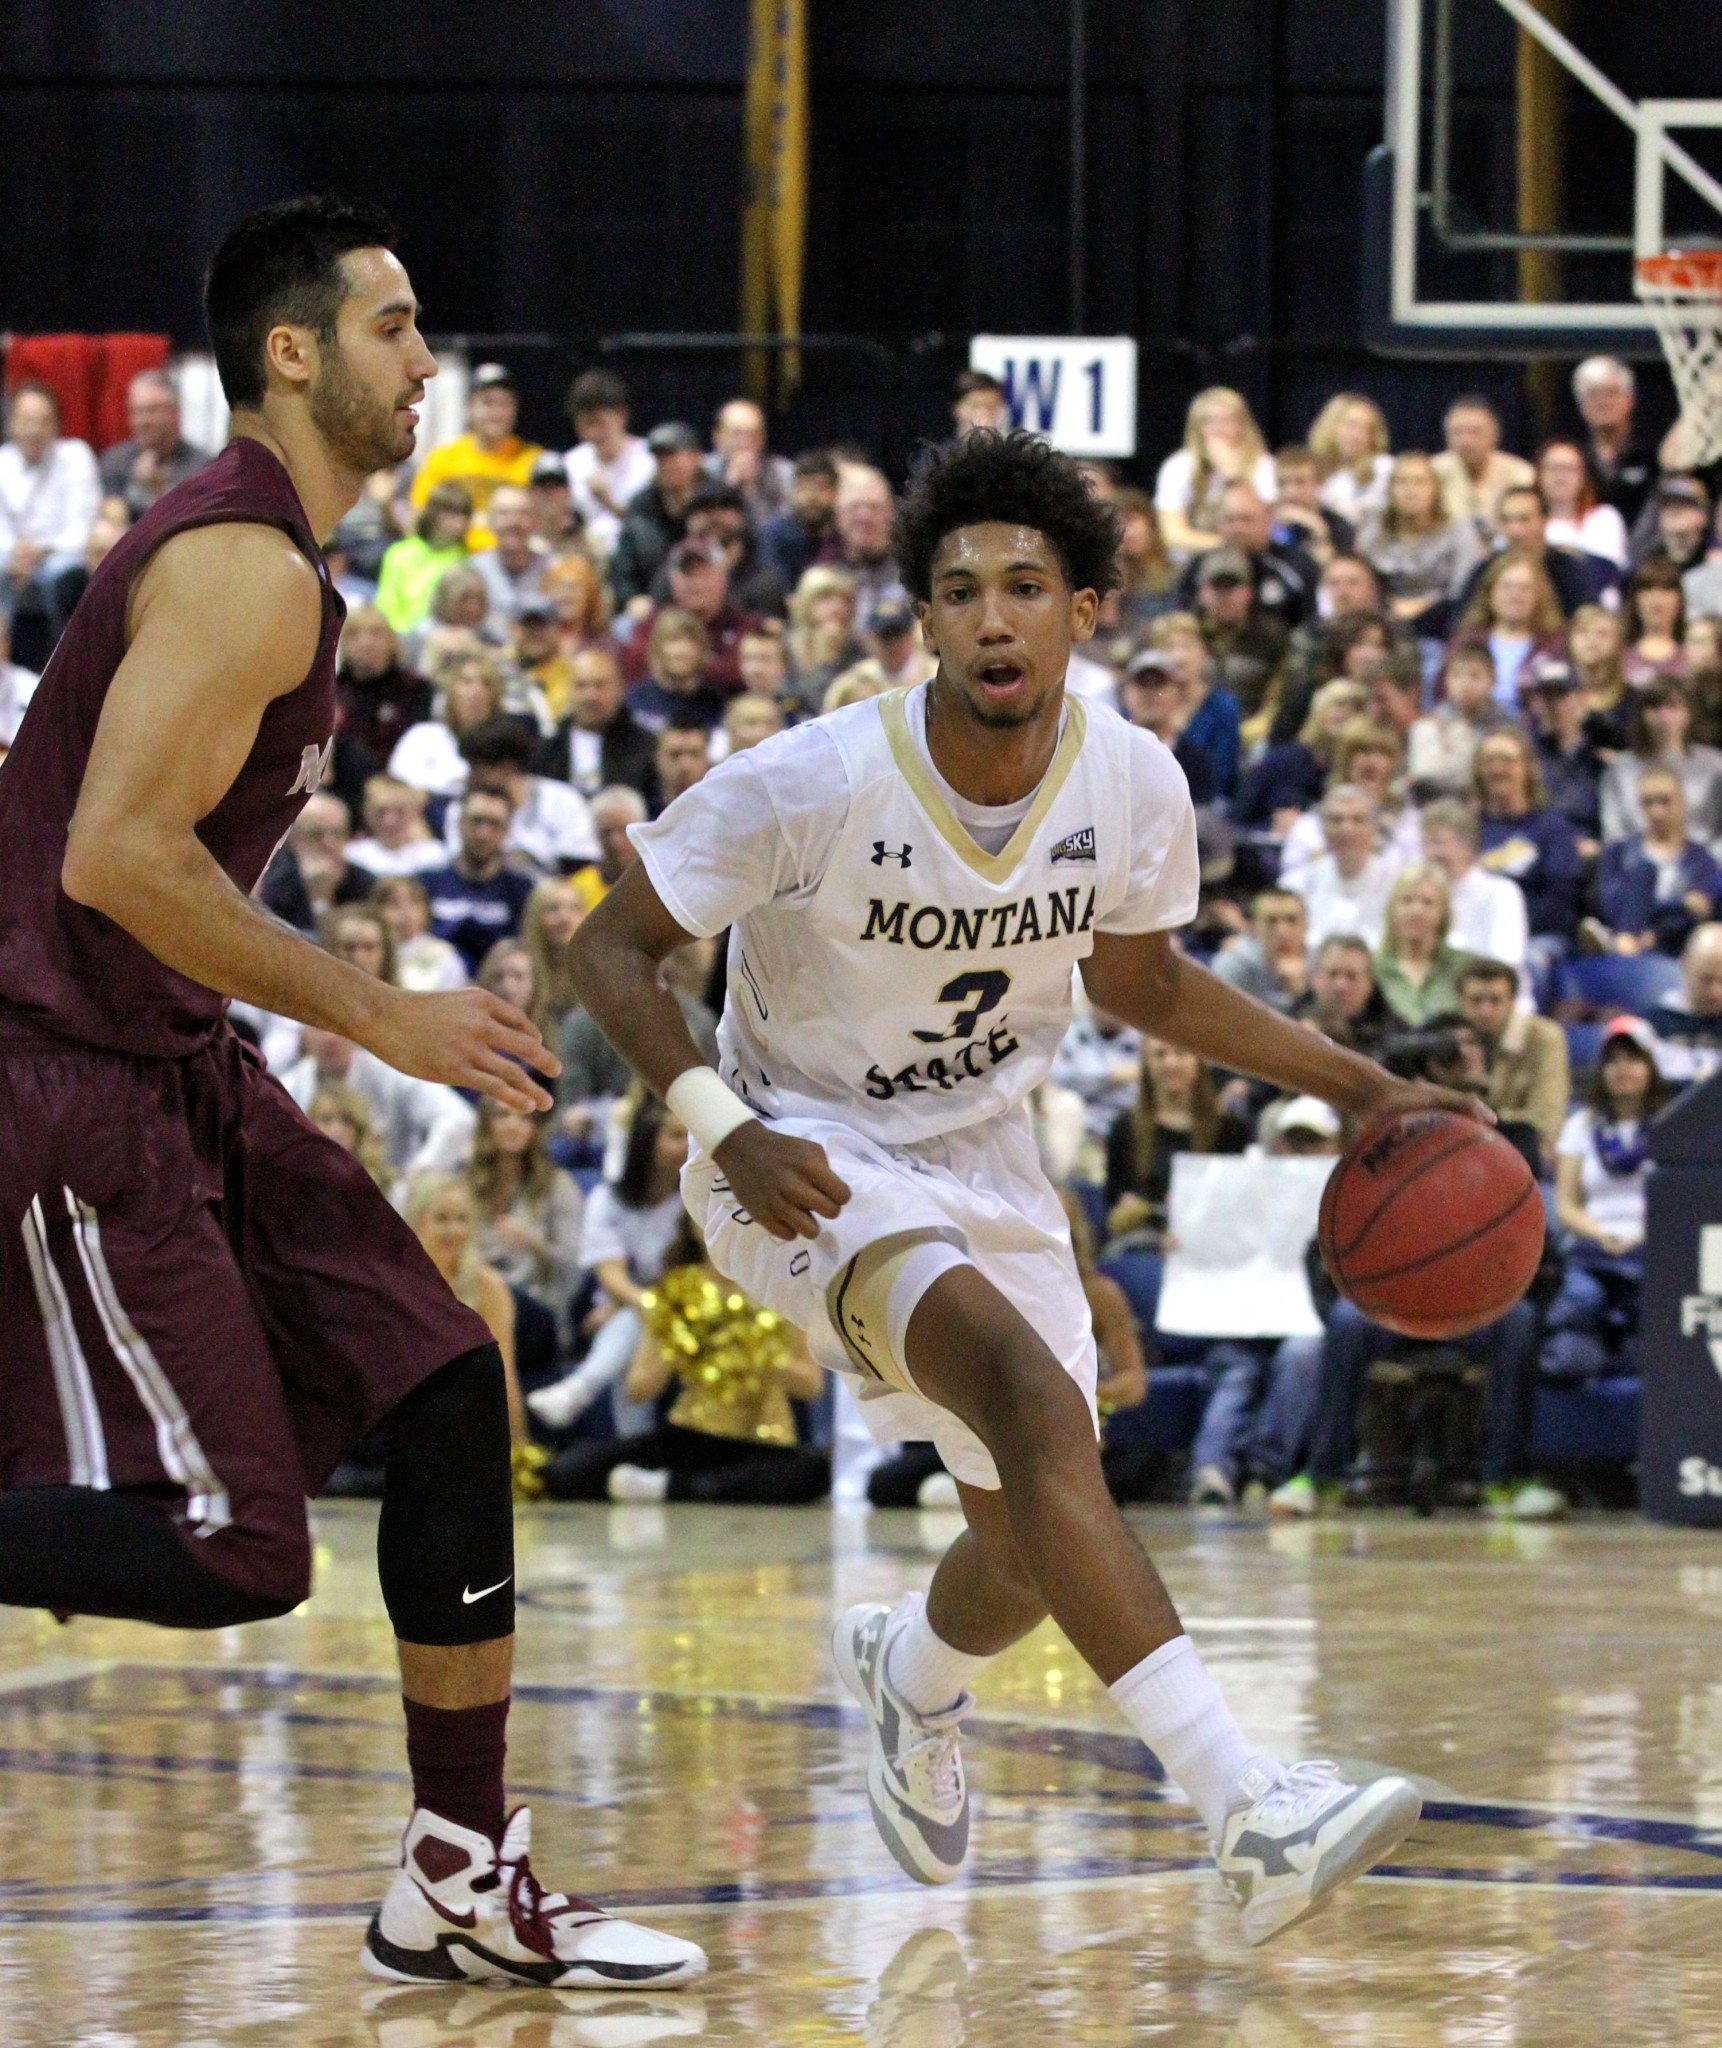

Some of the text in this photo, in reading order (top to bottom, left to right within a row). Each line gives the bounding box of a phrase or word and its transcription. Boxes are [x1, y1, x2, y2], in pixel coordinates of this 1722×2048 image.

[1002, 358, 1103, 433] W 1
[1065, 829, 1094, 852] SKY
[908, 966, 1014, 1043] 3
